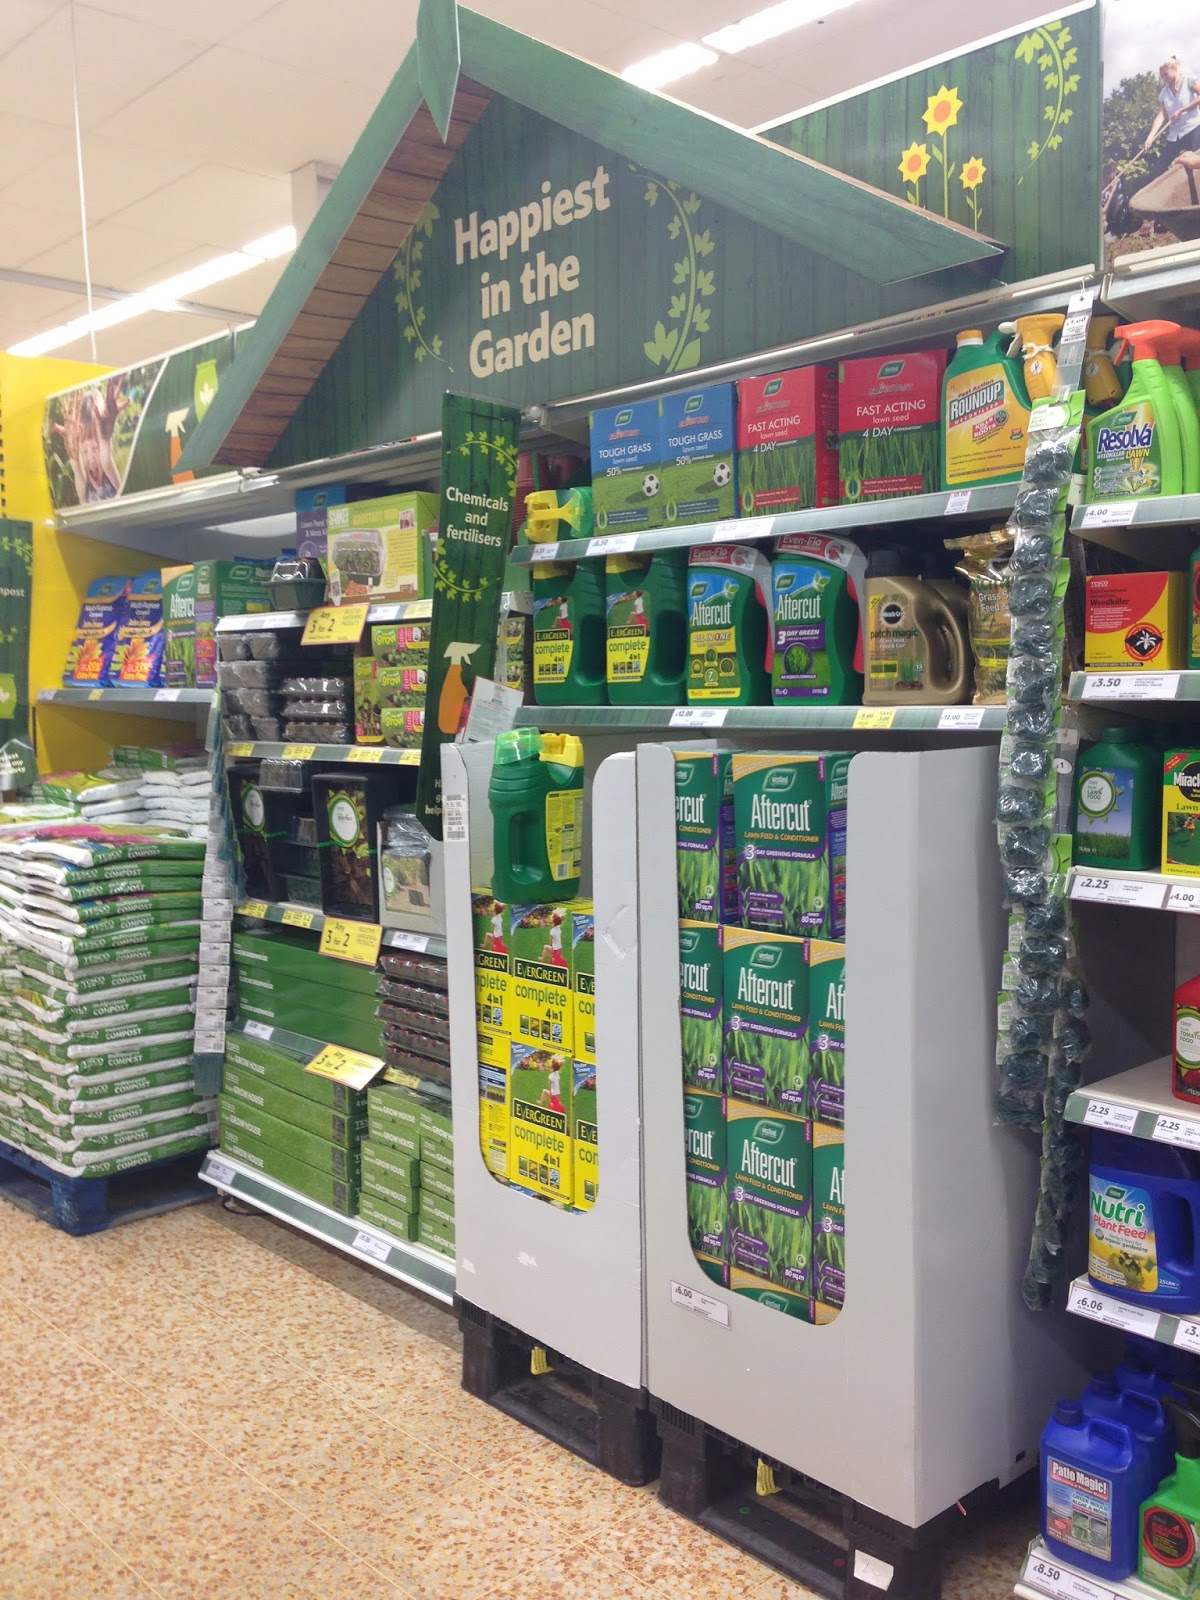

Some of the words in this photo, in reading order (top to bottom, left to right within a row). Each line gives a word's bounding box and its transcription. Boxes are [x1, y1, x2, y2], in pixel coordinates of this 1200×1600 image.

[454, 166, 610, 265] Happiest
[481, 272, 511, 319] in
[520, 251, 580, 305] the
[469, 310, 595, 378] Garden
[856, 405, 881, 417] FAST
[883, 399, 926, 414] ACTING
[950, 381, 1002, 421] ROUNDUP
[747, 423, 766, 433] FAST
[768, 415, 801, 430] ACTING
[873, 415, 890, 424] lawn
[892, 413, 910, 423] seed
[668, 435, 696, 447] TOUGH
[697, 430, 722, 444] GRASS
[760, 431, 773, 440] lawn
[774, 428, 788, 437] seed
[862, 428, 869, 438] 4
[872, 426, 893, 438] DAY
[1097, 423, 1153, 452] Resolva
[599, 447, 625, 459] TOUGH
[627, 443, 652, 456] GRASS
[682, 445, 694, 453] lawn
[696, 443, 708, 451] seed
[753, 444, 758, 453] 4
[760, 441, 777, 453] DAY
[1126, 448, 1150, 459] LAWN
[612, 456, 625, 465] lawn
[625, 455, 637, 463] seed
[676, 455, 692, 467] 50%
[606, 466, 622, 478] 50%
[446, 486, 509, 511] Chemicals
[465, 512, 488, 526] and
[1086, 508, 1108, 517] £4.00
[447, 525, 501, 547] fertilisers
[783, 534, 822, 547] Even-Flo
[978, 593, 1001, 602] Grass
[693, 601, 731, 627] Aftercut
[777, 594, 821, 621] Aftercut
[981, 604, 999, 613] Feed
[309, 620, 317, 633] 3
[327, 618, 335, 632] 2
[777, 631, 786, 644] 3
[871, 629, 892, 640] patch
[892, 628, 919, 639] magic
[534, 642, 570, 657] complete
[608, 637, 647, 654] complete
[1092, 678, 1121, 687] £3.50
[751, 793, 811, 831] Aftercut
[1176, 803, 1198, 811] Lawn
[760, 832, 774, 840] FEED
[780, 834, 819, 843] CONDITIONER
[745, 844, 755, 859] 3
[766, 850, 791, 858] GREENING
[791, 851, 815, 859] FORMULA
[1080, 878, 1109, 890] £2.25
[1170, 893, 1194, 902] £4.00
[801, 915, 808, 923] 80
[326, 930, 333, 944] 3
[342, 933, 350, 947] 2
[515, 983, 567, 1008] complete
[738, 966, 794, 1011] Aftercut
[731, 1002, 746, 1011] LAWN
[746, 1004, 759, 1014] FEED
[764, 1009, 801, 1023] CONDITIONER
[731, 1015, 740, 1031] 3
[750, 1023, 774, 1034] GREENING
[774, 1028, 797, 1039] FORMULA
[1180, 1036, 1193, 1044] FOOD
[1088, 1105, 1110, 1115] £2.25
[1157, 1120, 1180, 1131] £2.25
[514, 1124, 565, 1154] complete
[741, 1138, 796, 1188] Aftercut
[735, 1172, 748, 1182] LAWN
[749, 1177, 761, 1187] FEED
[767, 1185, 804, 1201] CONDITIONER
[735, 1186, 743, 1202] 3
[744, 1192, 754, 1201] DAY
[754, 1196, 776, 1209] GREENING
[777, 1203, 800, 1216] FORMULA
[1091, 1190, 1145, 1228] Nutri
[1094, 1214, 1117, 1234] Plant
[1118, 1225, 1147, 1241] Feed
[1122, 1240, 1148, 1254] gardening
[785, 1269, 792, 1277] 80
[675, 1286, 693, 1299] £6.00
[1077, 1297, 1103, 1312] £6.06
[1052, 1461, 1075, 1482] Patio
[1075, 1470, 1107, 1496] Magic!
[1033, 1563, 1060, 1580] £8.50
